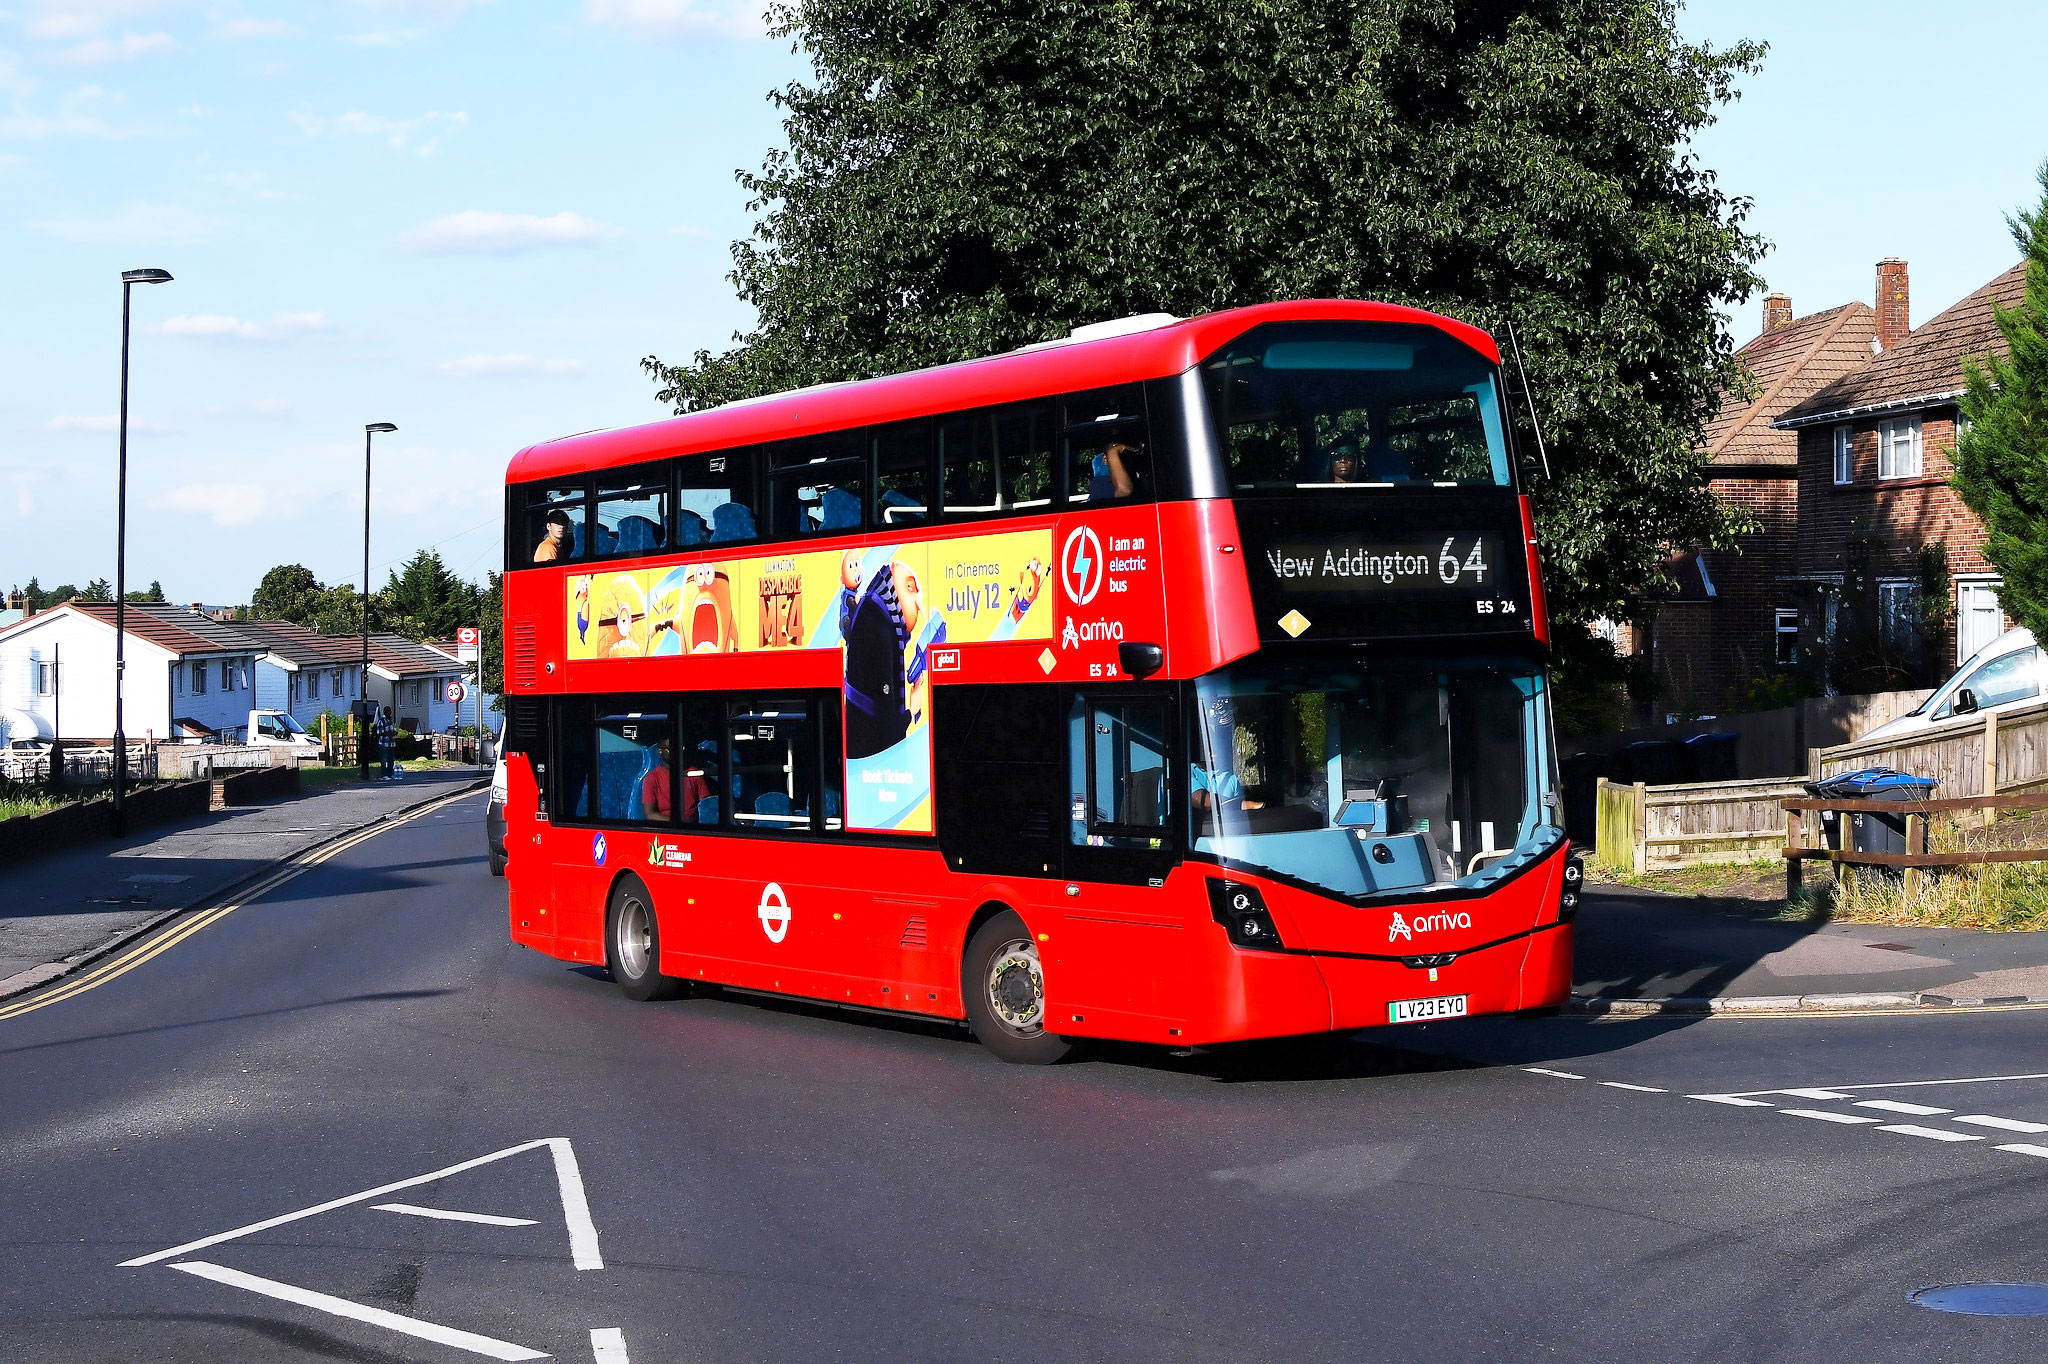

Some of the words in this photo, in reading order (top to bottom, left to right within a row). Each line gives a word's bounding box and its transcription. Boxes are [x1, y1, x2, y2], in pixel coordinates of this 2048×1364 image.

[1114, 539, 1131, 551] am
[1132, 538, 1145, 551] an
[1109, 557, 1147, 572] electric
[1267, 549, 1314, 578] New
[1322, 548, 1429, 584] Addington
[1438, 536, 1488, 584] 64
[945, 565, 953, 579] In
[956, 562, 1000, 578] Cinemas
[758, 574, 802, 597] DESPICABLE
[1109, 578, 1128, 593] bus
[946, 584, 981, 619] July
[984, 583, 1000, 610] 12
[1476, 600, 1494, 613] ES
[1501, 600, 1516, 613] 24
[1080, 617, 1124, 641] arriva
[1089, 664, 1102, 677] ES
[1106, 663, 1118, 676] 24
[448, 687, 460, 697] 30
[862, 769, 883, 784] Book
[1413, 909, 1472, 933] arriva
[1398, 1001, 1434, 1019] LV23
[1438, 997, 1463, 1015] EYO
